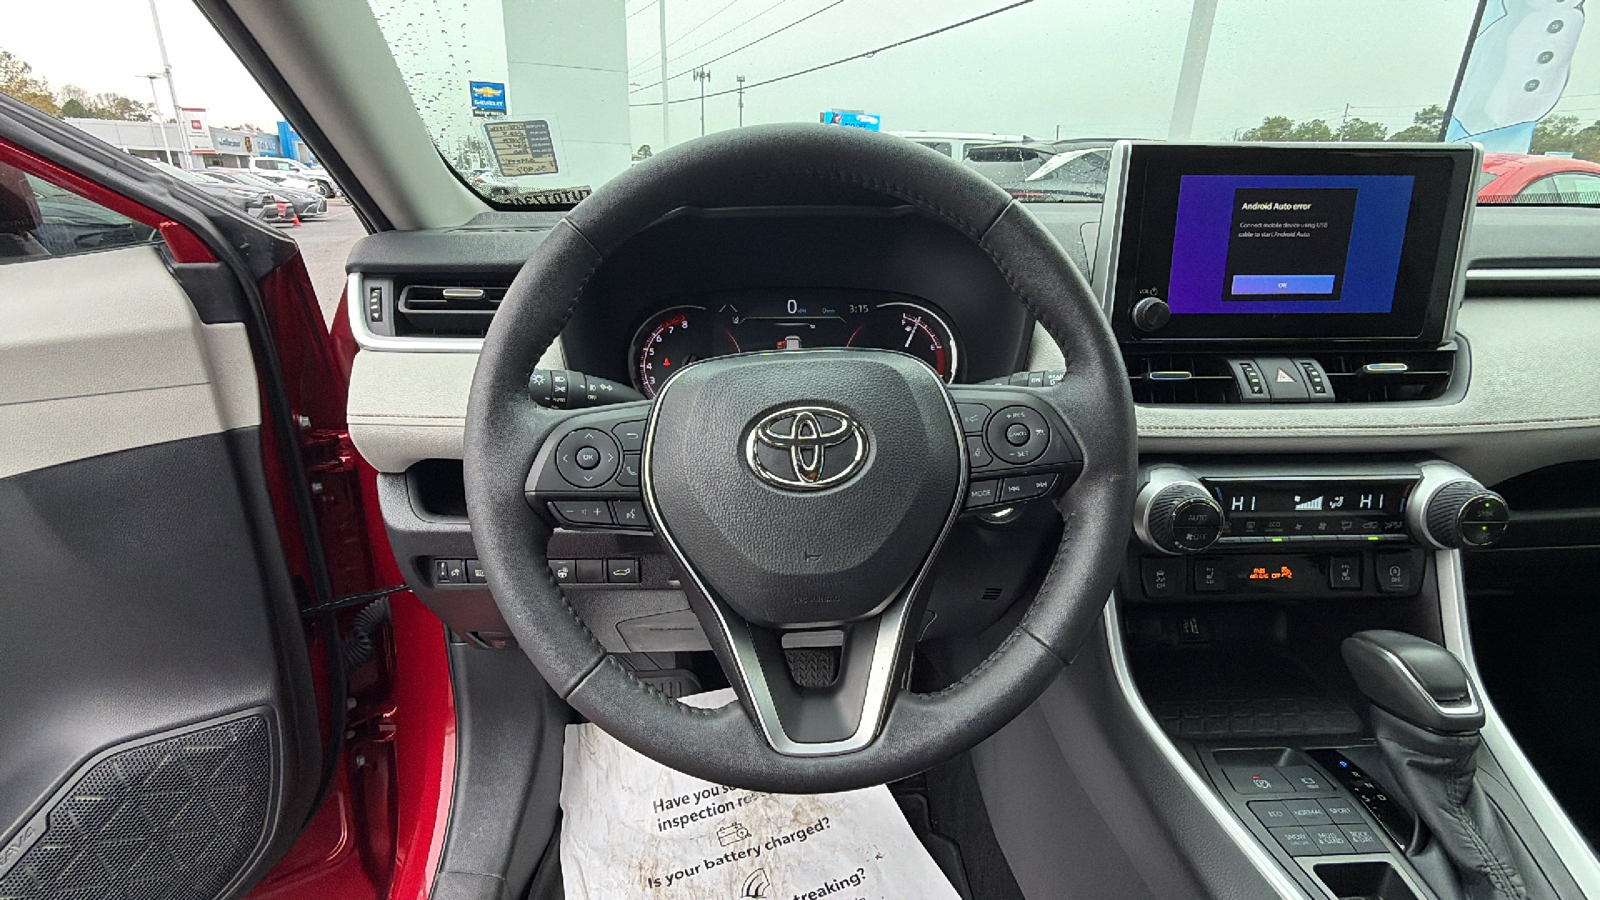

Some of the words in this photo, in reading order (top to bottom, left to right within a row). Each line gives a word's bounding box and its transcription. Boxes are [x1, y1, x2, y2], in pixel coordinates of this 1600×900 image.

[1241, 201, 1273, 211] Android
[1273, 202, 1293, 211] Auto
[1292, 202, 1312, 211] error
[1300, 222, 1315, 230] using
[787, 299, 797, 314] 0
[849, 304, 869, 314] 3:15
[681, 320, 688, 329] 8
[656, 335, 662, 343] 6
[649, 348, 655, 356] 5
[649, 376, 656, 385] 3
[971, 489, 992, 498] MODE
[1188, 514, 1208, 522] AUTO
[1193, 533, 1208, 541] OFF
[652, 793, 697, 814] Have
[693, 785, 720, 804] you
[657, 800, 736, 832] inspection
[647, 876, 662, 889] Is
[664, 864, 701, 887] your
[702, 844, 761, 870] battery
[764, 816, 831, 850] charged?
